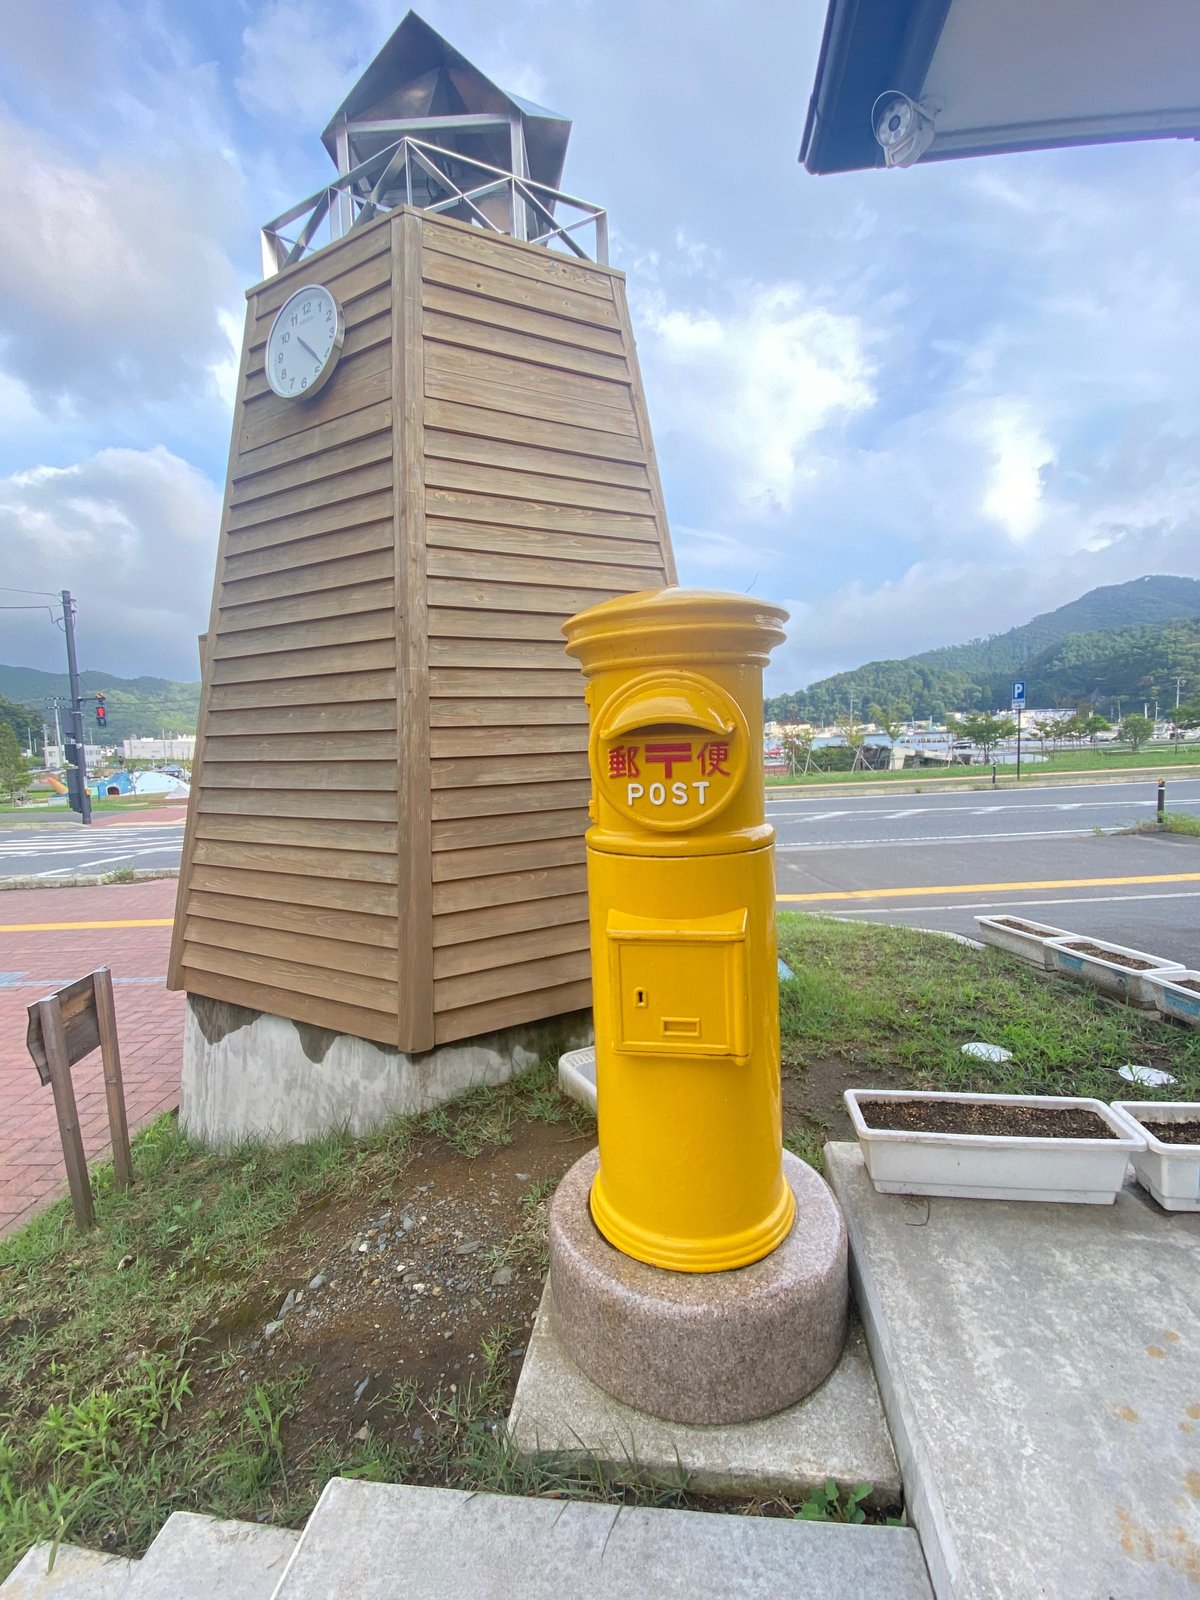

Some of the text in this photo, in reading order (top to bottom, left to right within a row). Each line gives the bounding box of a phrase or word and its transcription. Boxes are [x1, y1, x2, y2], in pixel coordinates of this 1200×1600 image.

[302, 302, 312, 315] 12
[317, 301, 322, 313] 1
[291, 313, 298, 327] 11
[326, 310, 332, 322] 2
[281, 332, 291, 345] 10
[329, 327, 335, 339] 3
[278, 352, 284, 364] 9
[281, 368, 287, 380] 8
[289, 377, 296, 390] 7
[301, 377, 308, 389] 6
[1014, 683, 1023, 698] P
[627, 781, 710, 806] POST
